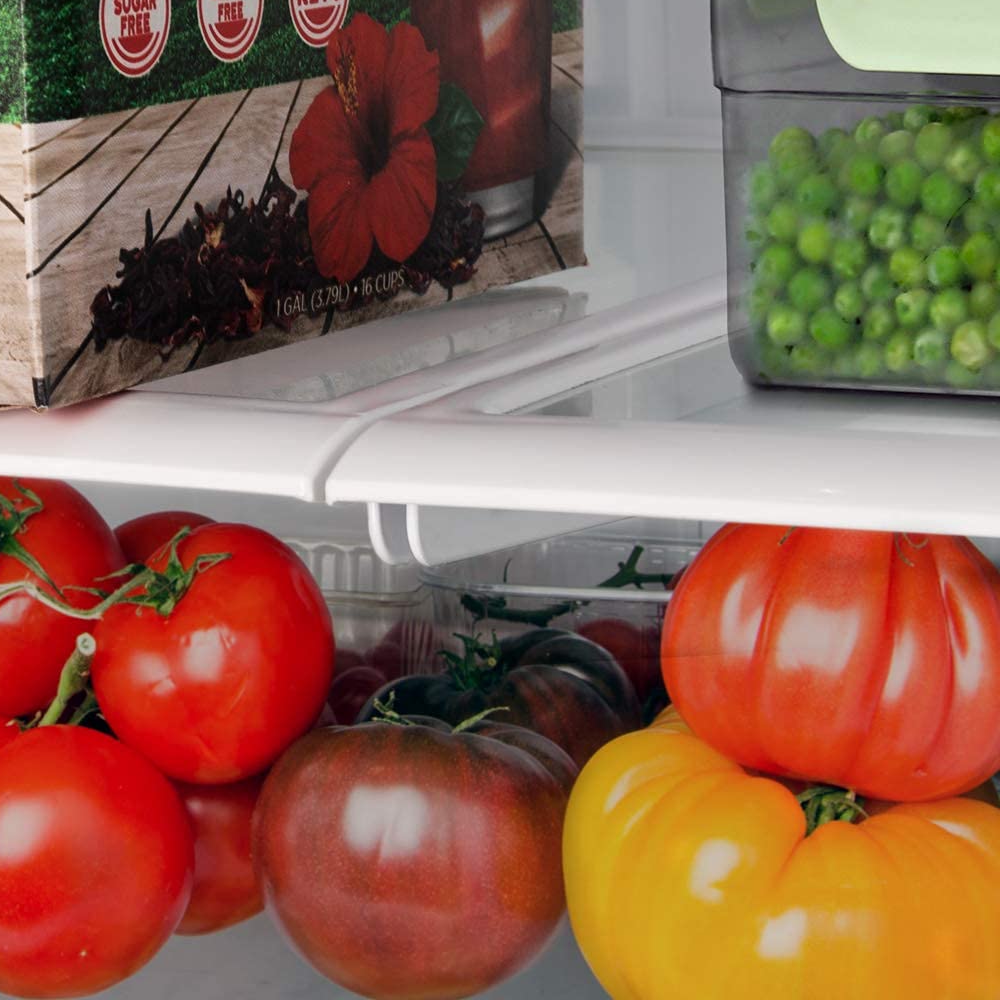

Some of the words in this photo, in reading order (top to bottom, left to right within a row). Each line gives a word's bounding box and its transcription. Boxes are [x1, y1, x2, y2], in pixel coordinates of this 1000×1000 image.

[217, 0, 244, 22] FREE
[120, 12, 151, 37] FREE
[276, 300, 281, 317] 1
[284, 293, 307, 315] GAL
[311, 283, 350, 312] (3.79L)
[361, 277, 373, 296] 16
[375, 269, 405, 293] CUPS
